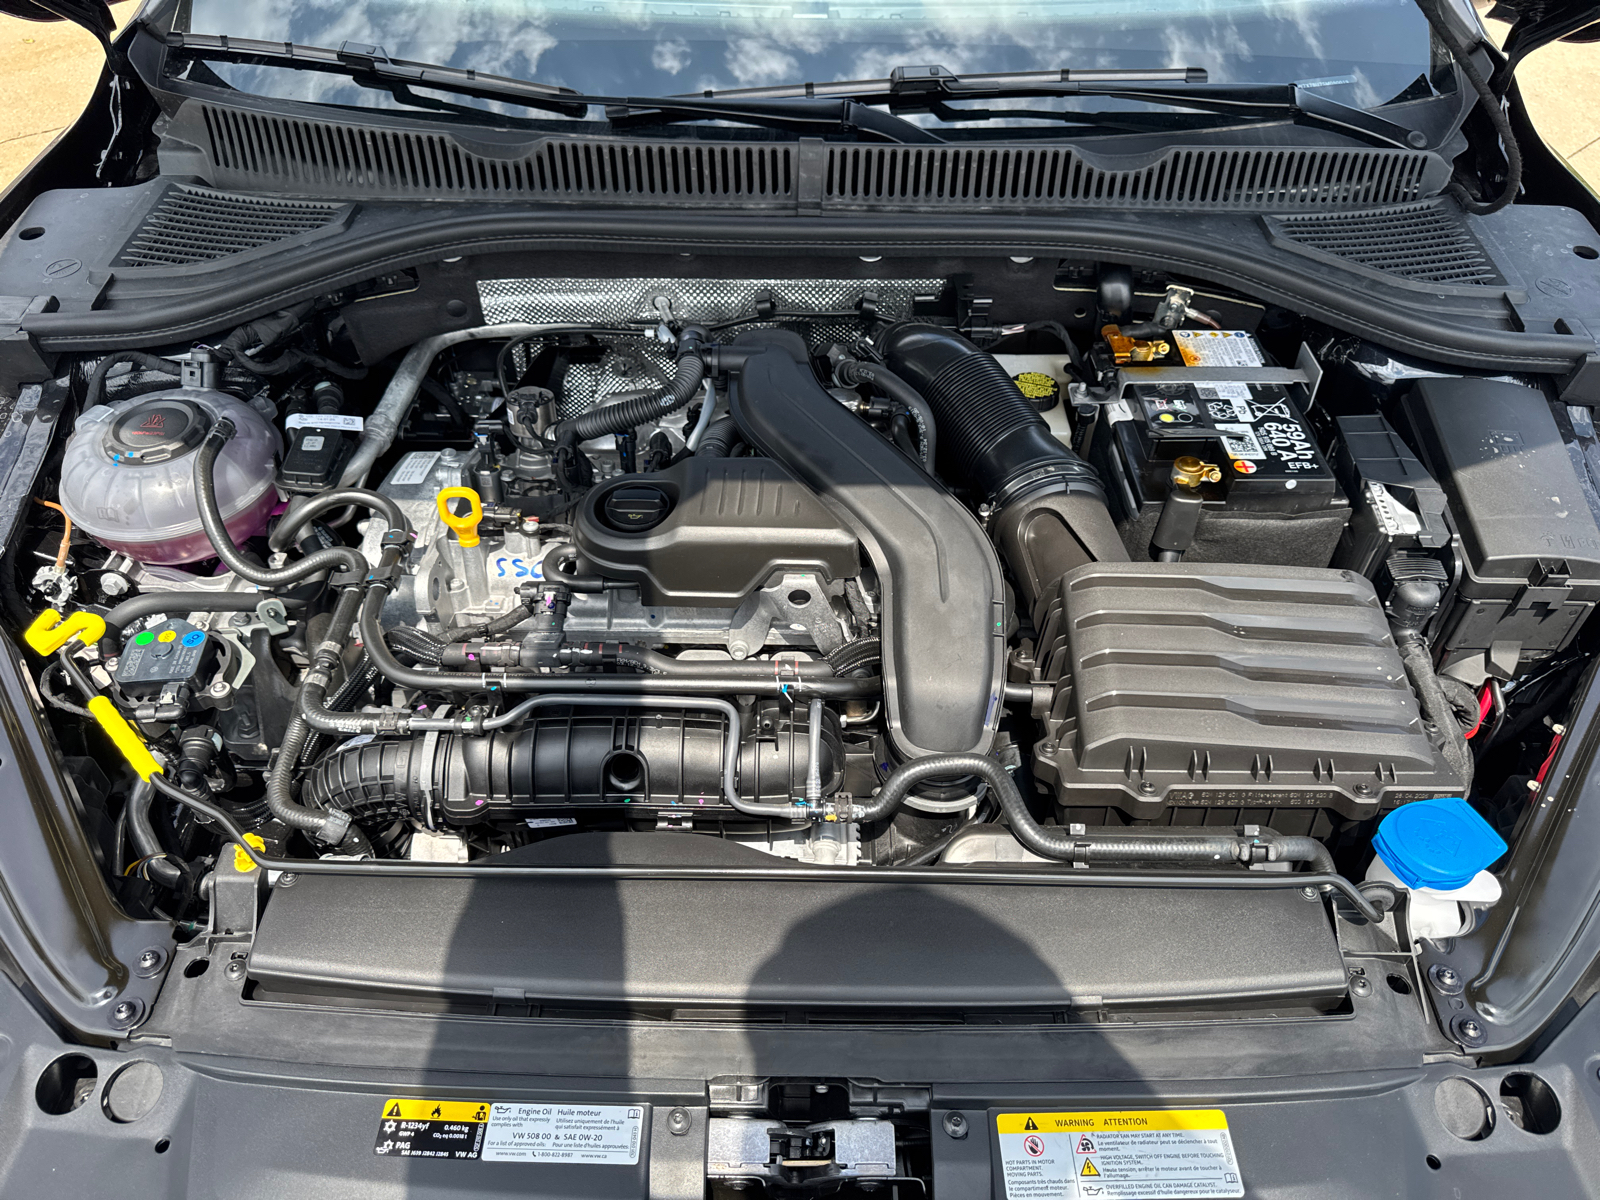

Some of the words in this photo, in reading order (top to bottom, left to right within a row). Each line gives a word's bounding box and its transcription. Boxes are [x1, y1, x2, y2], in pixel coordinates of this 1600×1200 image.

[1236, 406, 1247, 414] Pb
[1264, 422, 1291, 447] 640
[1282, 424, 1315, 460] 59Ah
[1276, 450, 1298, 461] A
[518, 1108, 541, 1116] Engine
[1055, 1119, 1094, 1127] WARNING
[1103, 1118, 1148, 1126] ATTENTION
[400, 1121, 430, 1131] R-1234yf
[461, 1125, 469, 1133] kg
